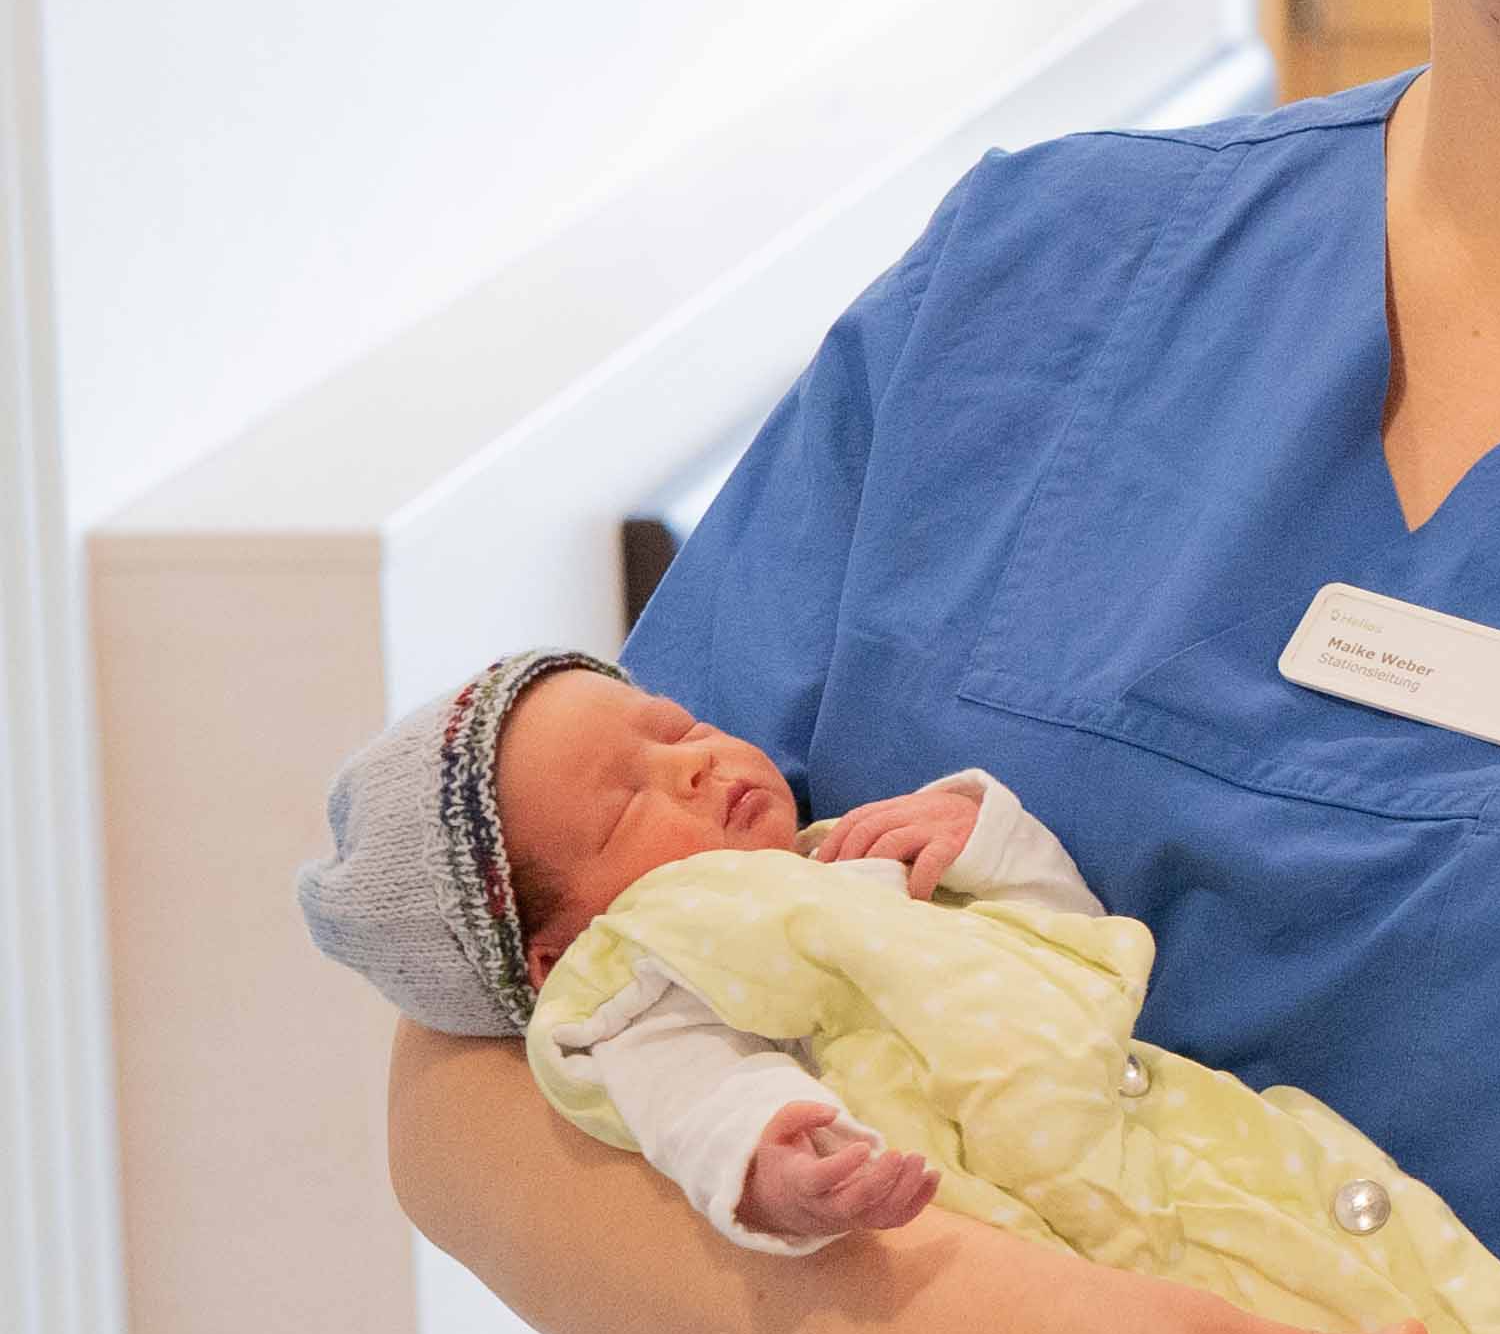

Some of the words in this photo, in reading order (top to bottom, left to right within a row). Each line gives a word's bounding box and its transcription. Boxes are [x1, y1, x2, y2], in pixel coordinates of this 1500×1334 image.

[1318, 651, 1422, 693] Stationsleitung
[1327, 636, 1376, 660] Maike
[1381, 651, 1435, 677] Weber
